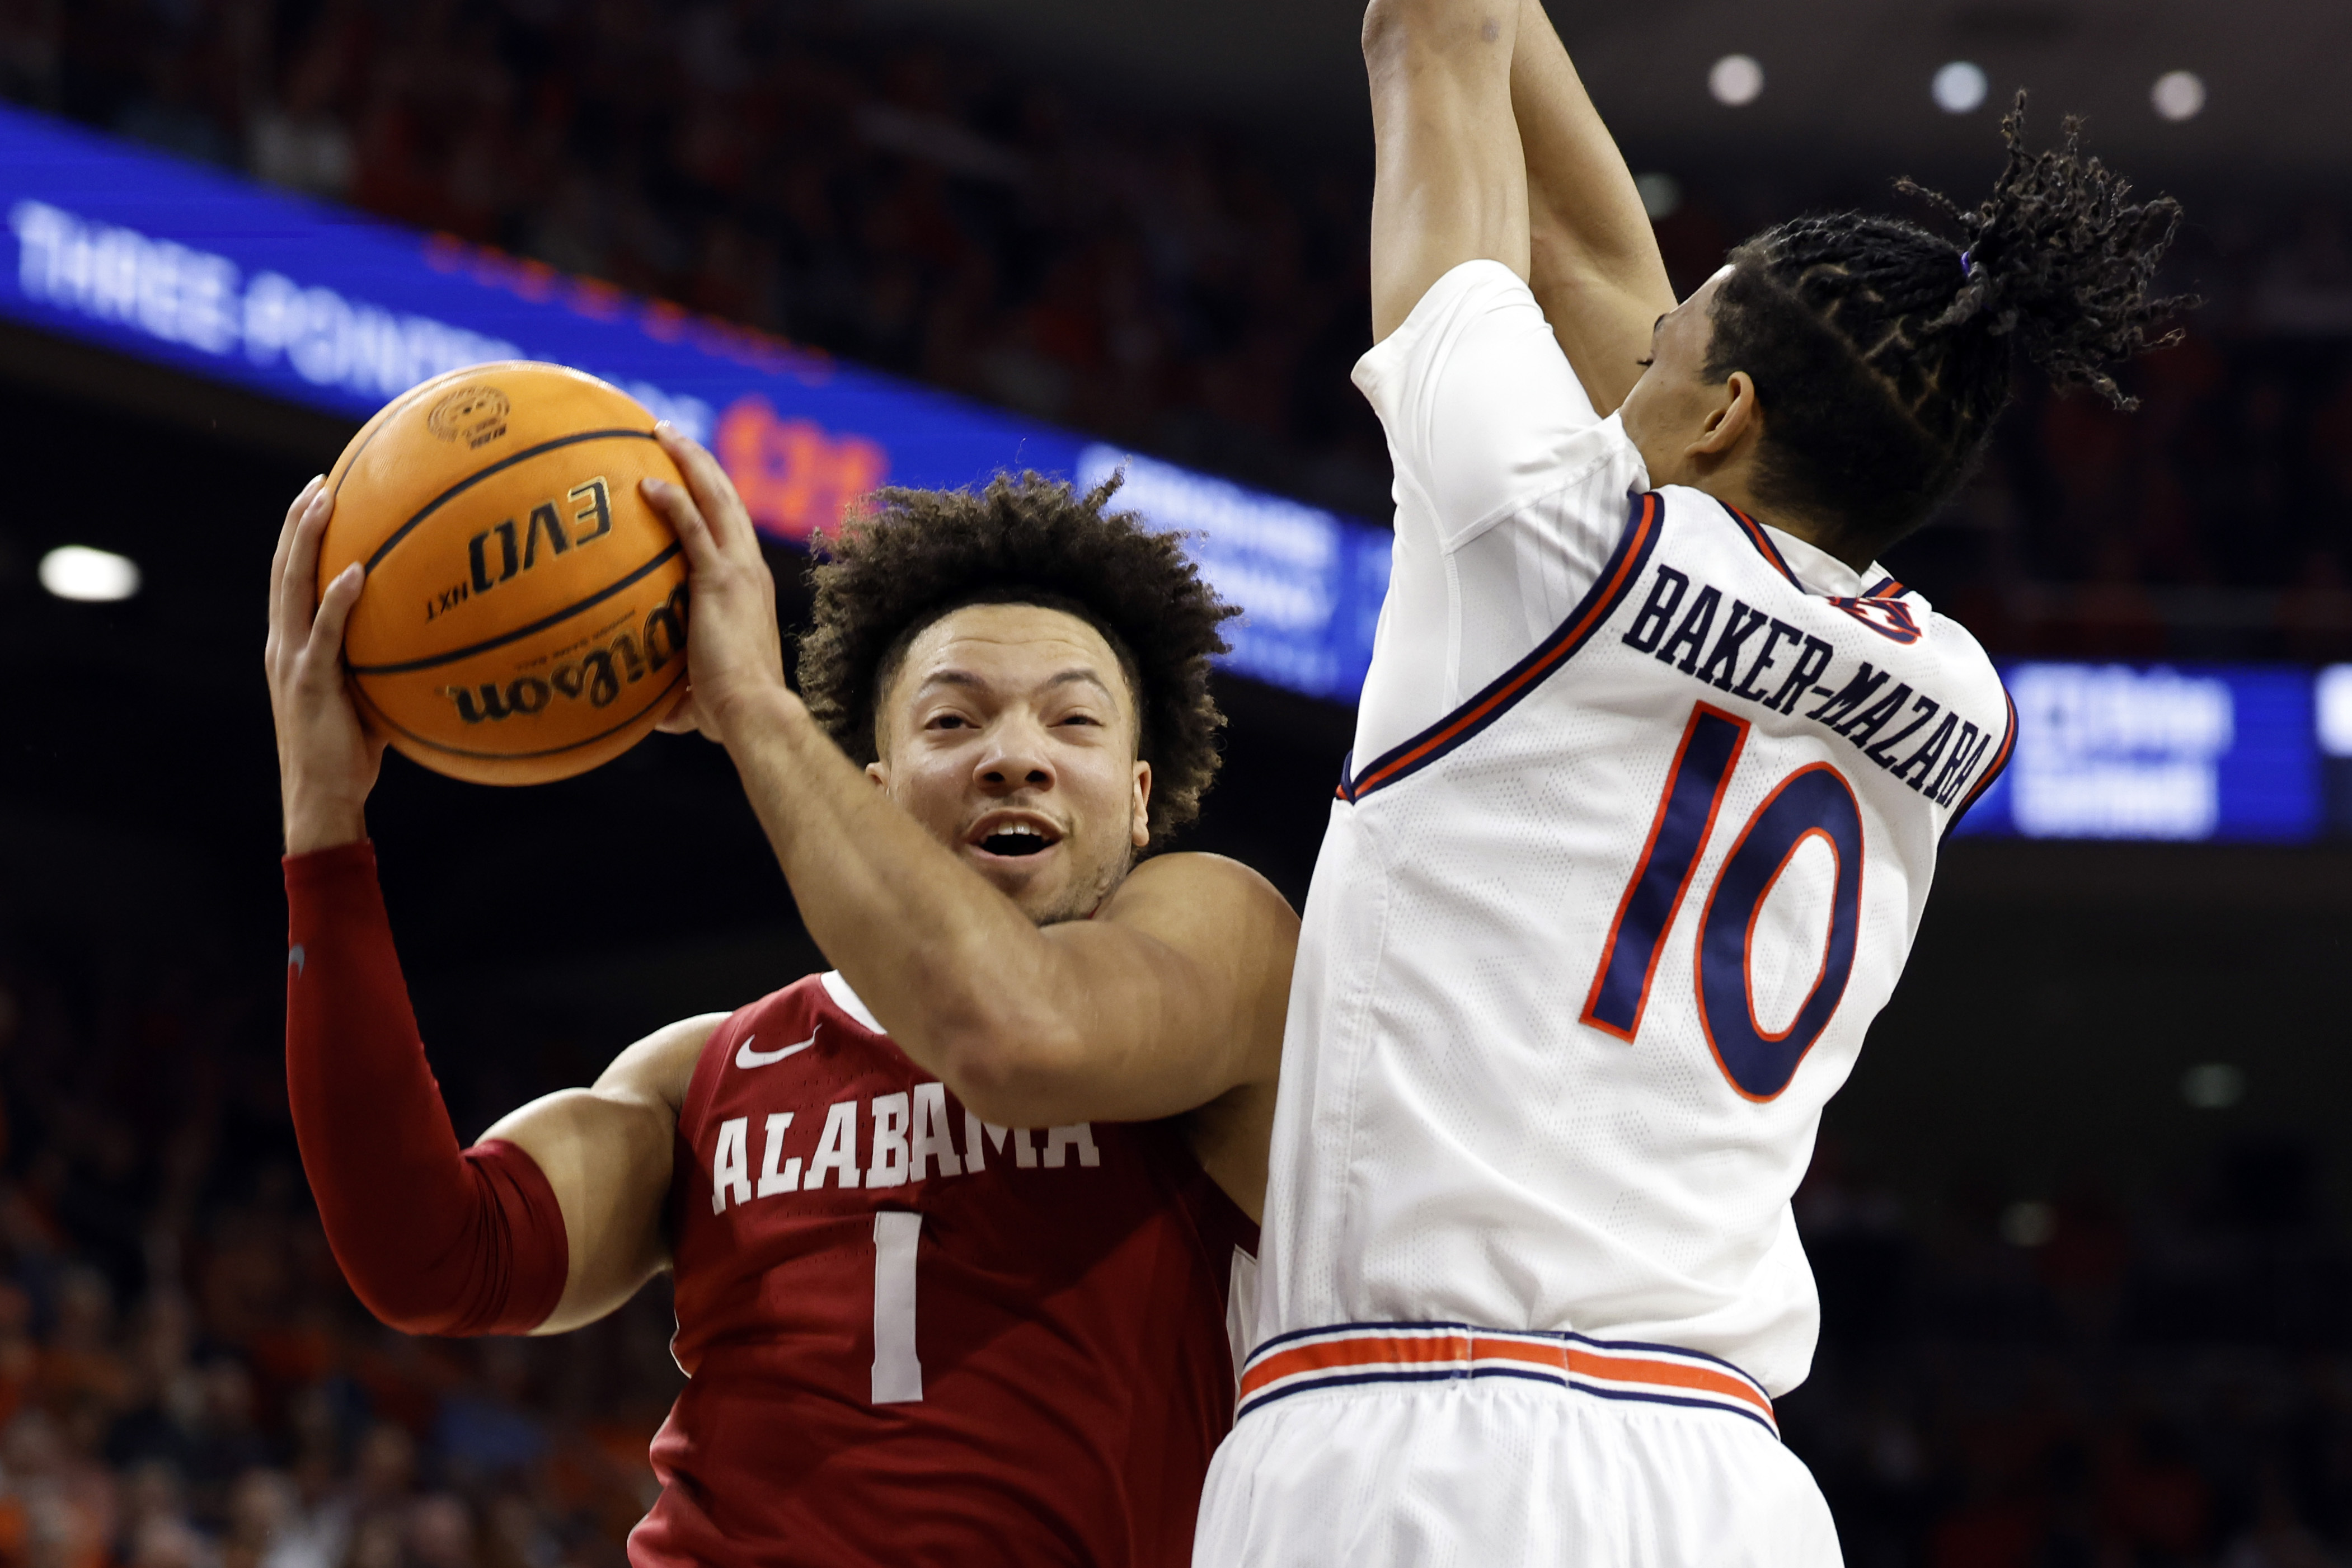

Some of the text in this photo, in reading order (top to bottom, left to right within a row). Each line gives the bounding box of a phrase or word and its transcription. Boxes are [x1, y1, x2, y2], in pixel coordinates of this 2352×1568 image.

[468, 475, 613, 594] EVO
[447, 582, 688, 724] Wilson
[1622, 564, 1991, 809] BAKER-MAZARA
[1579, 699, 1865, 1104] 10
[871, 1211, 923, 1405] 1
